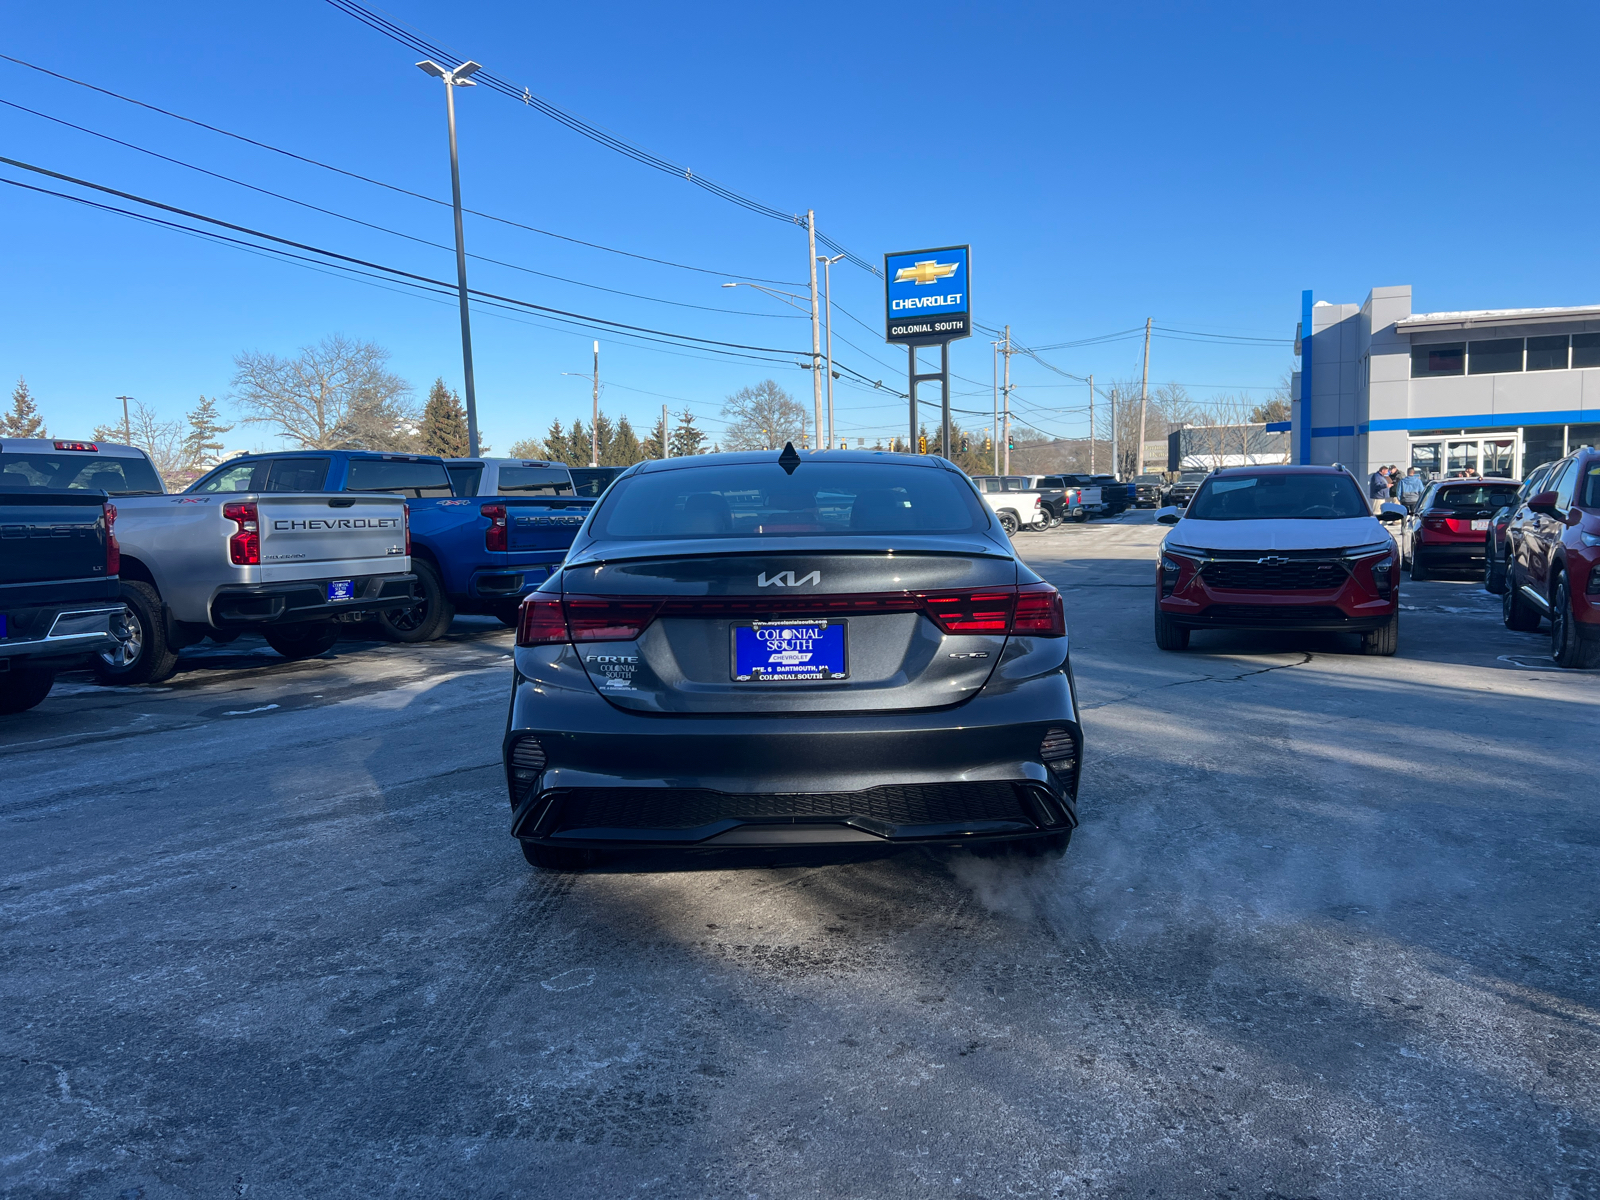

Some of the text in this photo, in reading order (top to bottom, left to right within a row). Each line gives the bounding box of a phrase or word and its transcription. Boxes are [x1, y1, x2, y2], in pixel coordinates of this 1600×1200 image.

[892, 293, 963, 311] CHEVROLET
[892, 320, 964, 335] COLONIAL SOUTH
[273, 518, 400, 531] CHEVROLET
[757, 570, 821, 588] KIA
[756, 628, 824, 641] COLONIAL
[766, 639, 813, 651] SOUTH
[586, 655, 639, 664] FORTE
[600, 664, 638, 672] COLONIAL
[605, 671, 632, 679] SOUTH
[759, 672, 823, 681] COLONIAL SOUTH
